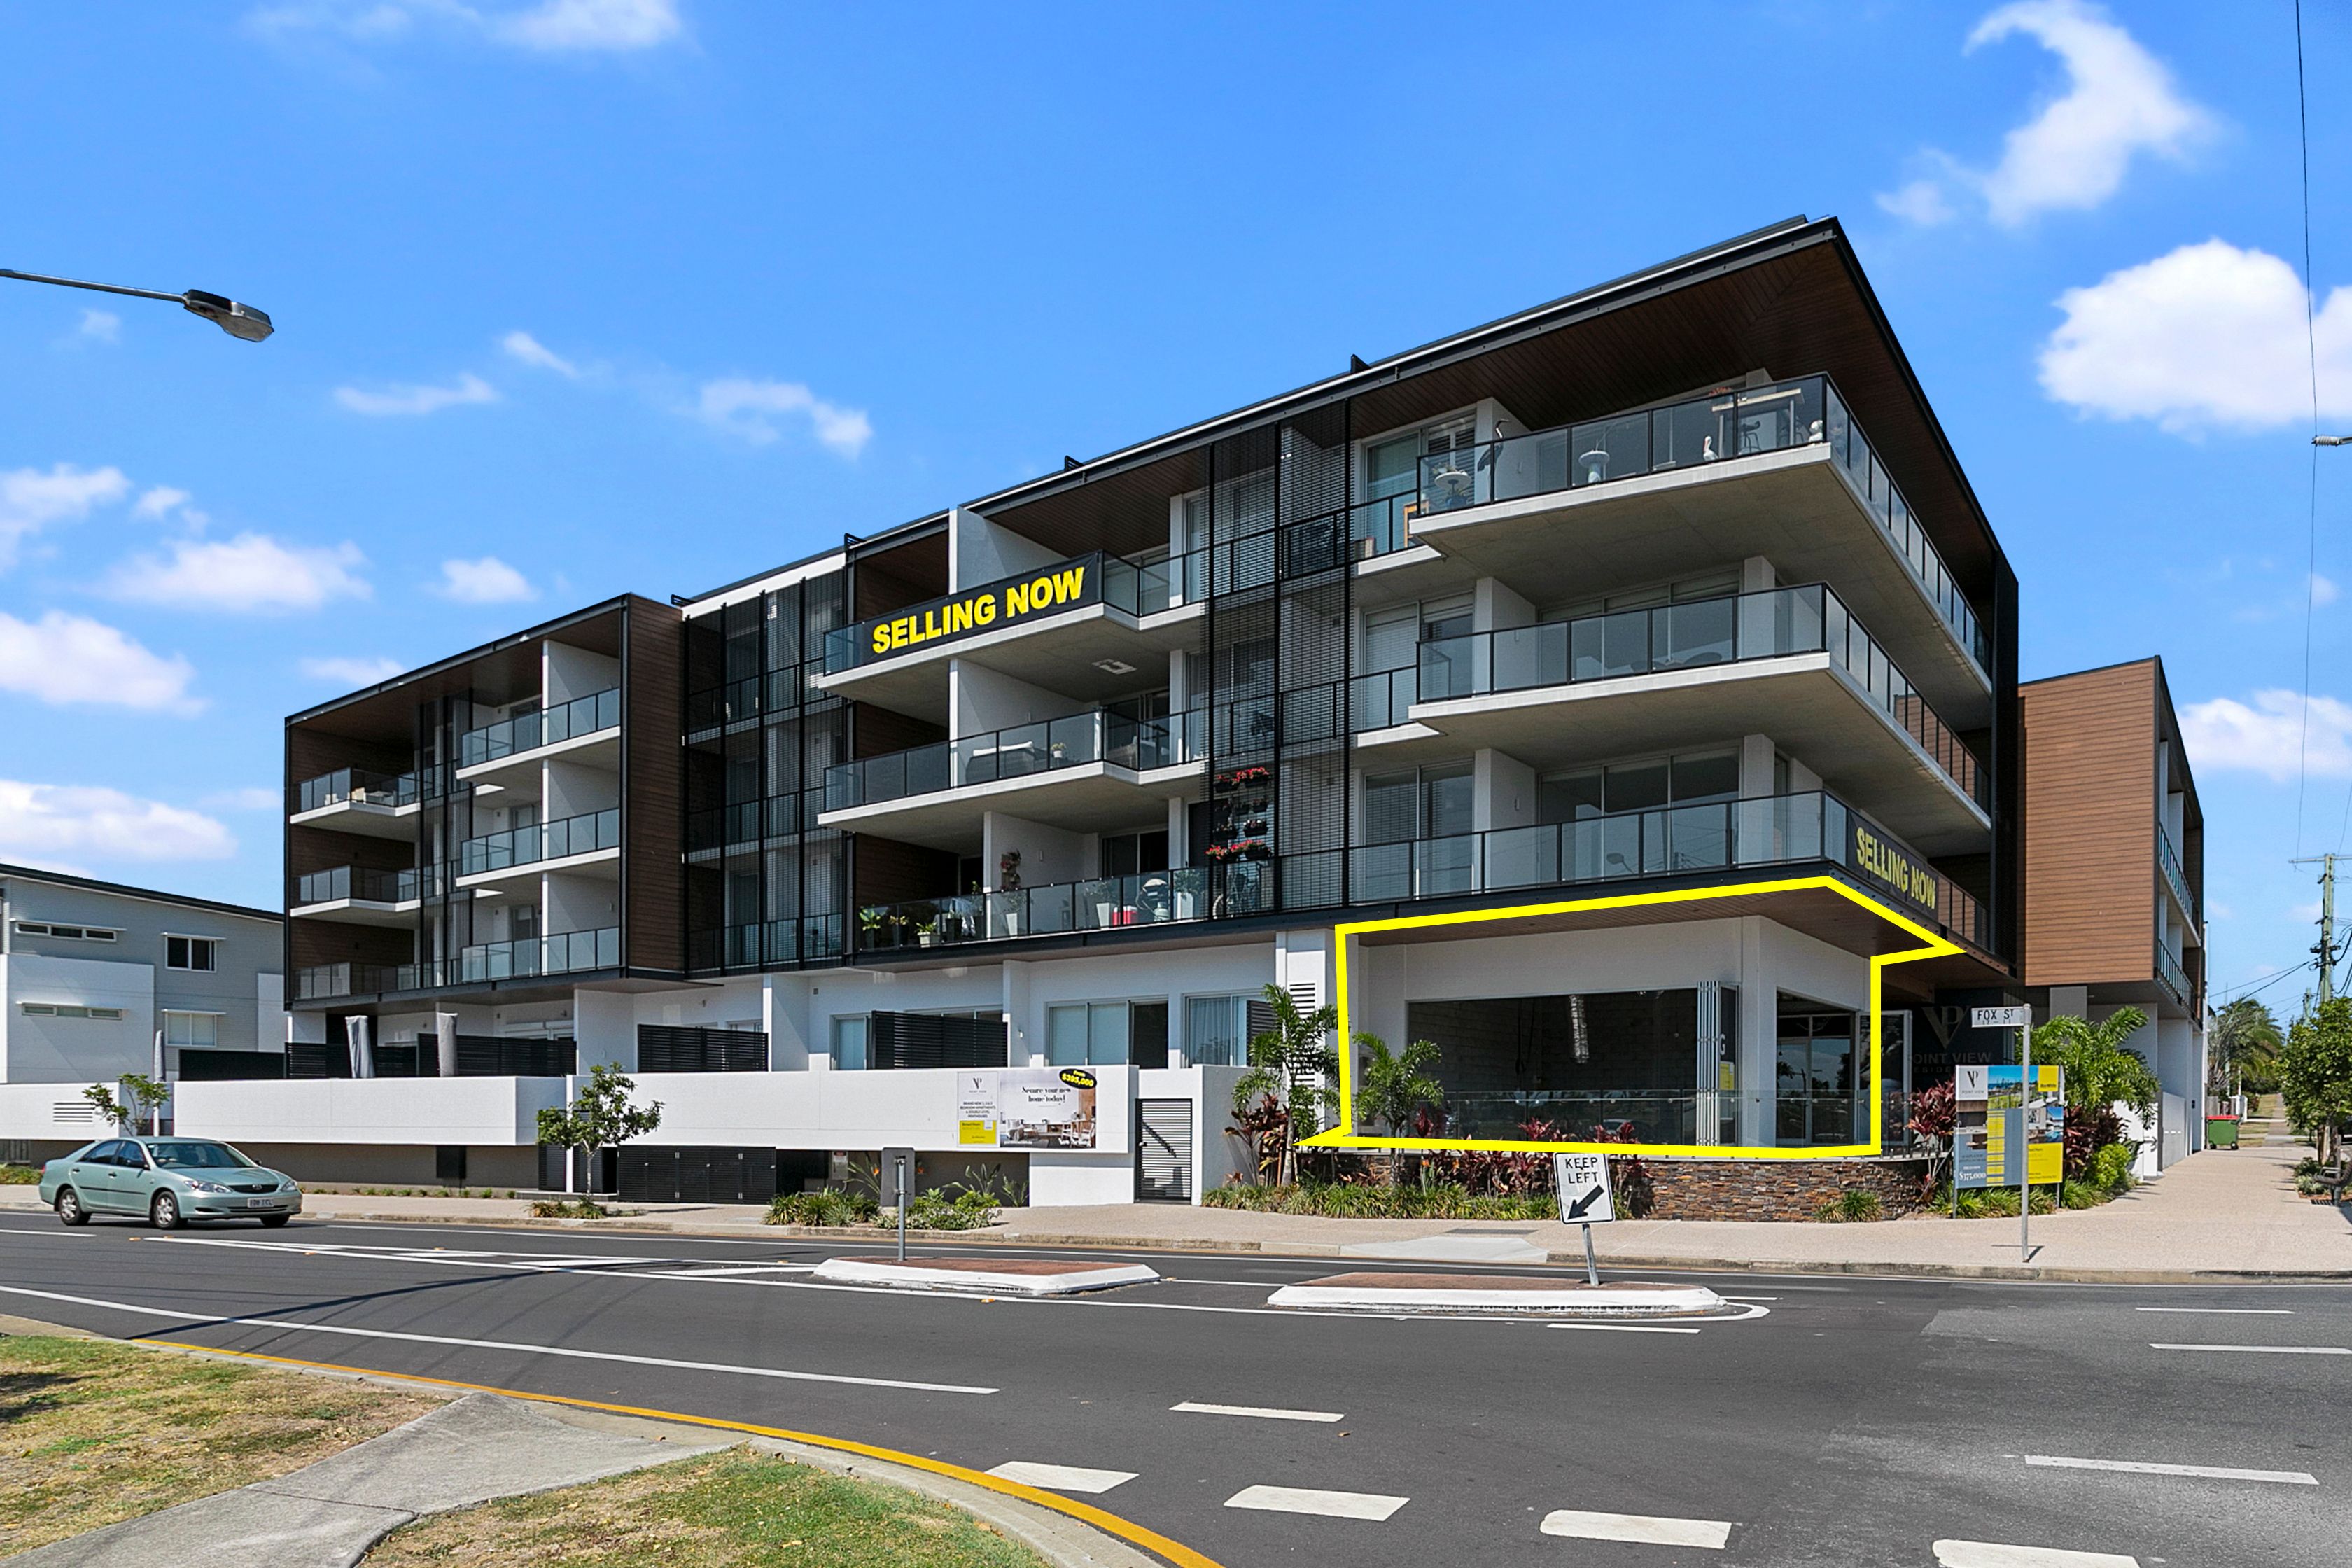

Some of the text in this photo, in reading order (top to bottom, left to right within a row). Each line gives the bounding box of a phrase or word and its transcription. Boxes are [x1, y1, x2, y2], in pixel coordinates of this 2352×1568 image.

[872, 566, 1085, 654] SELLING NOW
[1856, 827, 1936, 909] SELLING NOW
[1977, 1009, 2015, 1021] FOX ST
[1912, 1052, 1992, 1064] OINT VIEW
[1061, 1072, 1094, 1087] $395,000
[1046, 1094, 1065, 1105] today!
[1565, 1157, 1598, 1169] KEEP
[1568, 1172, 1597, 1184] LEFT
